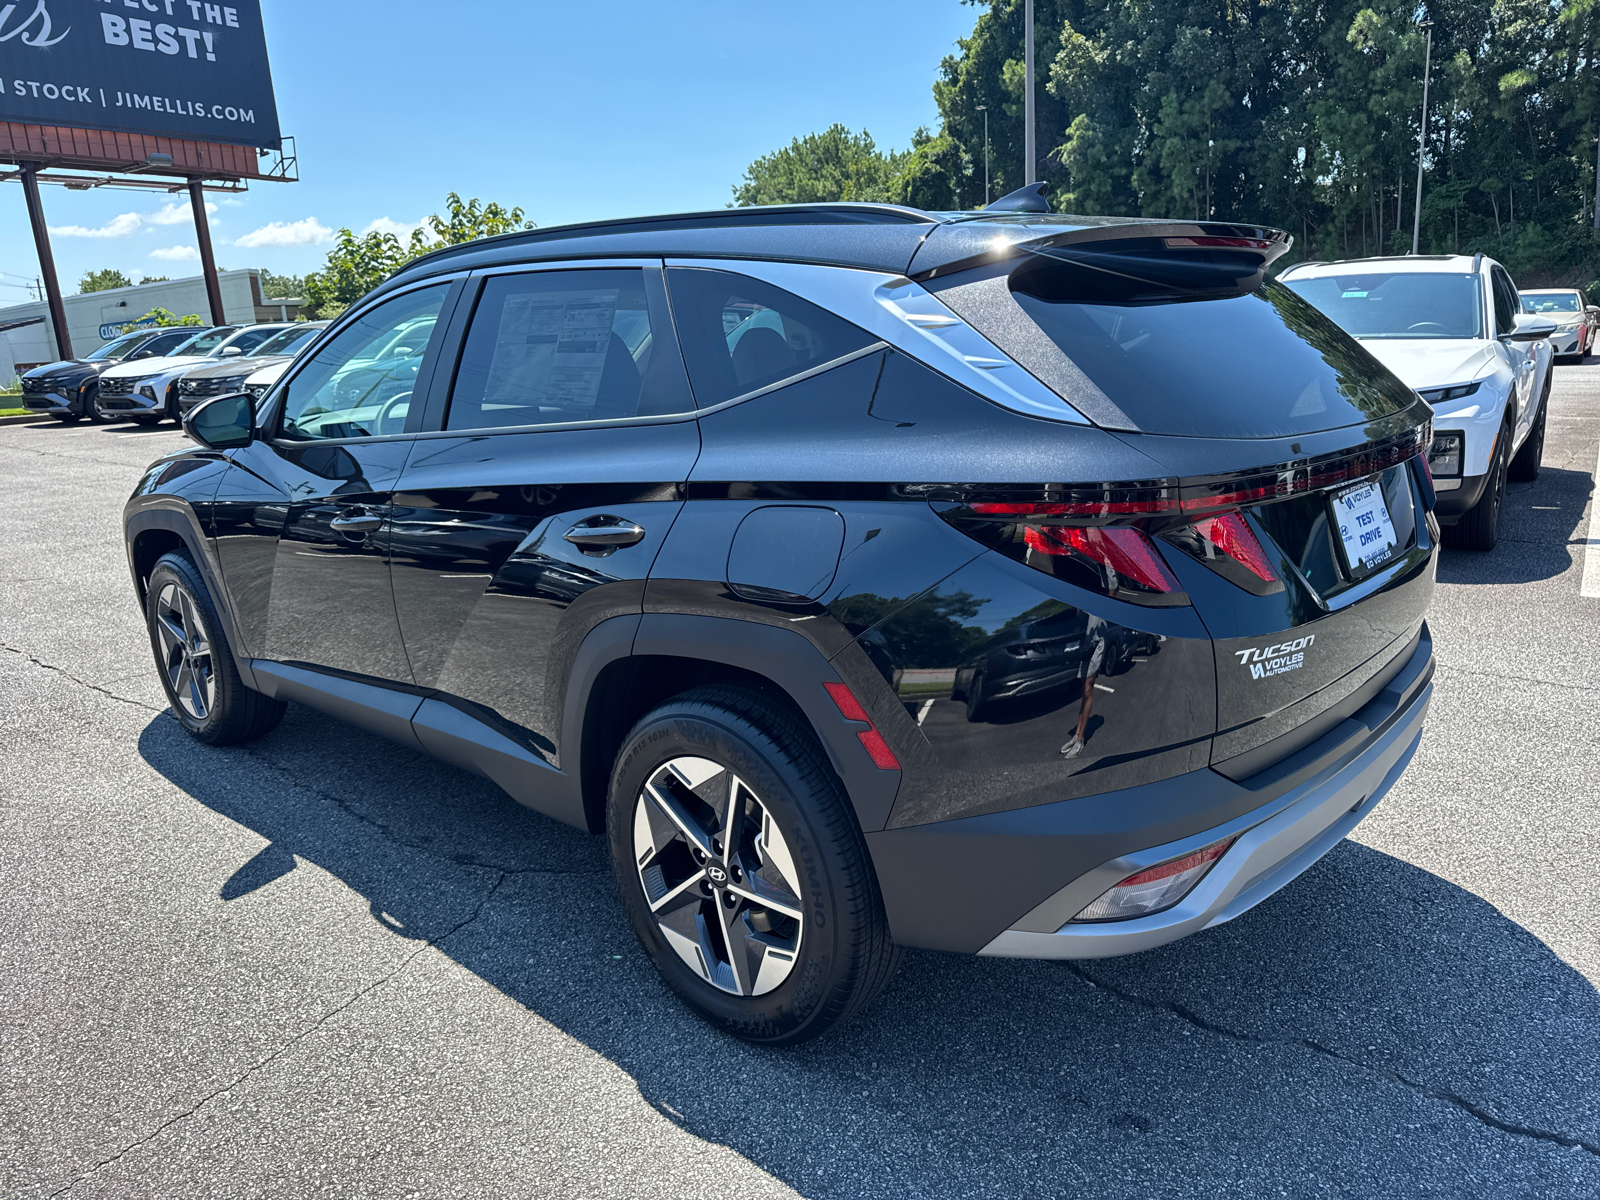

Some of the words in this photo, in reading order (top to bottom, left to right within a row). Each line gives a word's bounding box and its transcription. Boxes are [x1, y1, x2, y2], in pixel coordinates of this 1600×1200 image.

[186, 0, 239, 28] THE
[100, 12, 216, 62] BEST!
[13, 79, 92, 103] STOCK
[115, 91, 255, 124] JIMELLIS.COM
[1351, 489, 1372, 504] VOYLES
[1355, 510, 1375, 528] TEST
[1359, 526, 1382, 547] DRIVE
[1374, 550, 1392, 565] VOYLES
[1265, 652, 1304, 670] VOYLES
[1265, 661, 1303, 677] AUTOMOTIVE
[616, 754, 633, 787] 235/60
[632, 740, 648, 757] R18
[647, 728, 669, 744] 103H
[792, 826, 827, 930] KUMHO
